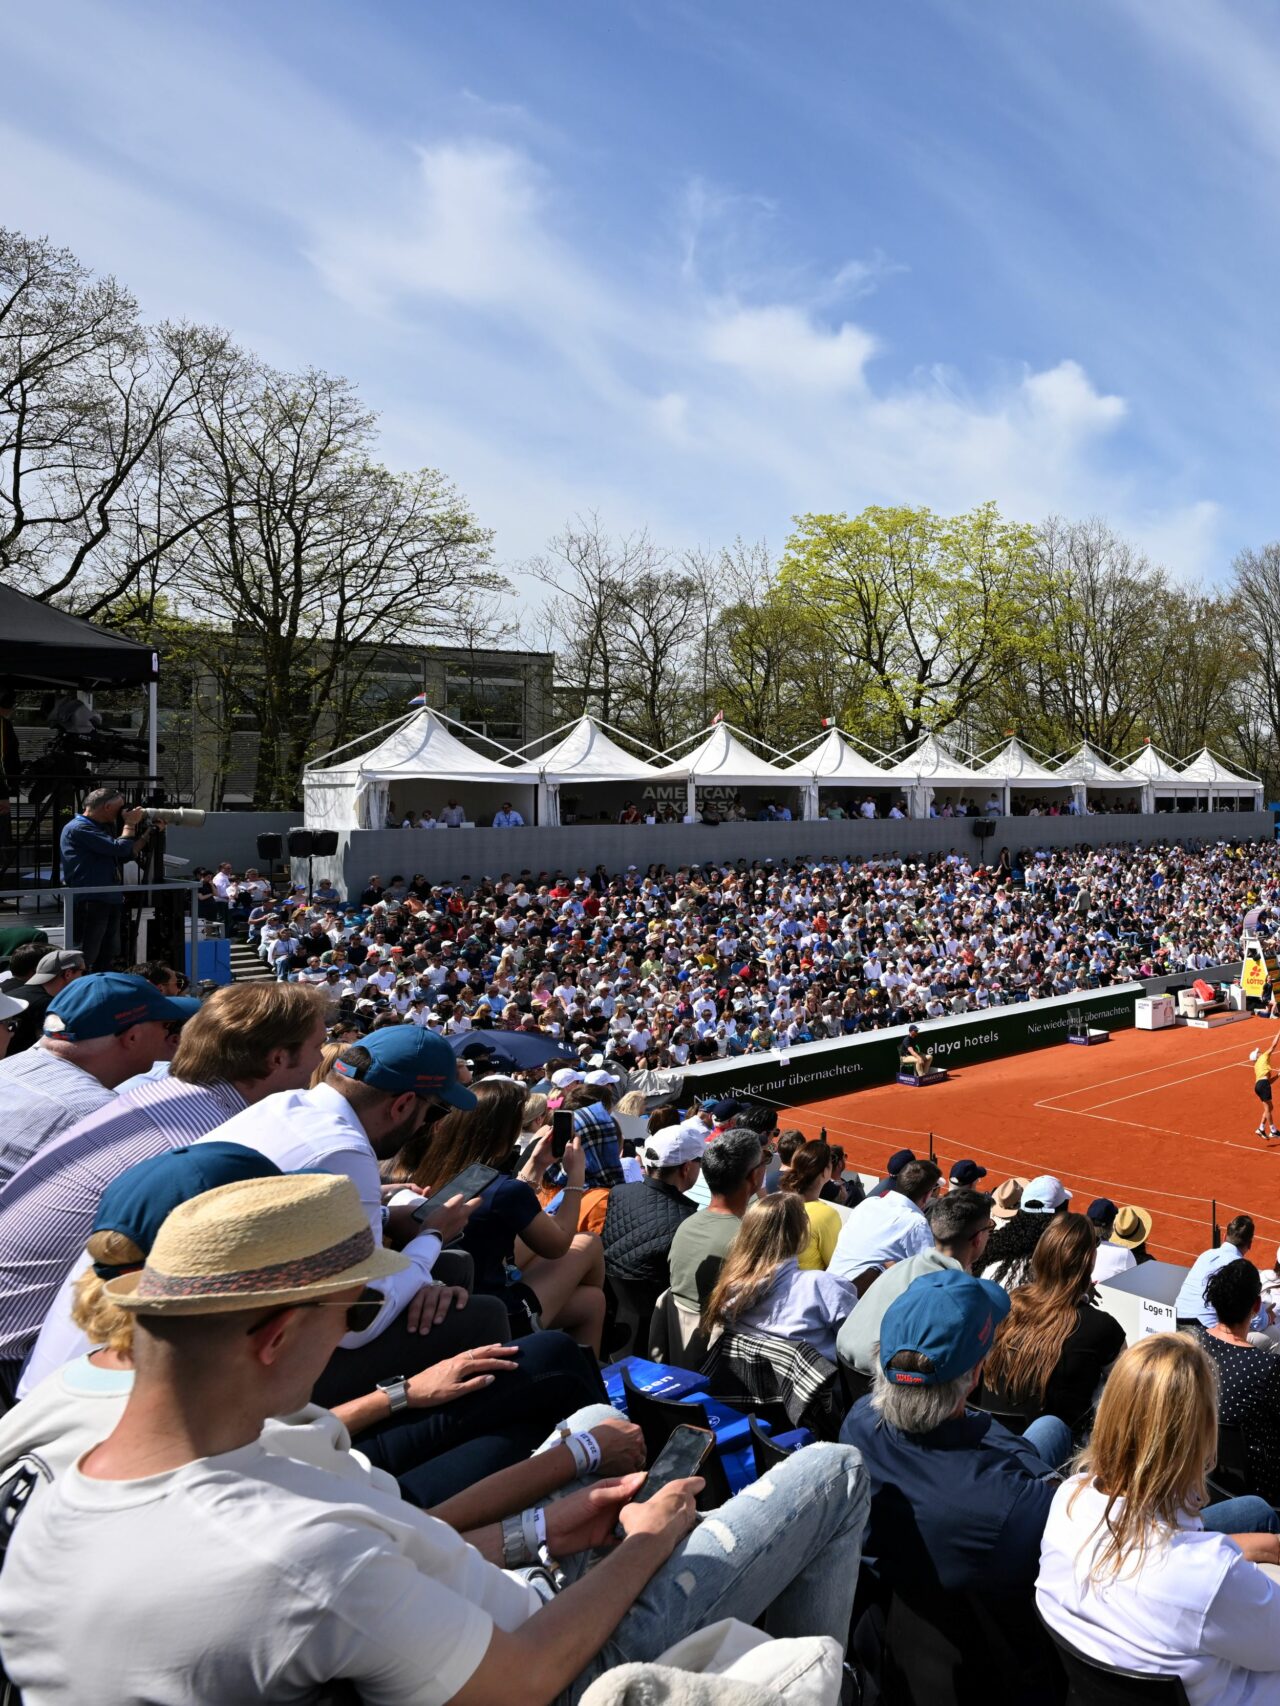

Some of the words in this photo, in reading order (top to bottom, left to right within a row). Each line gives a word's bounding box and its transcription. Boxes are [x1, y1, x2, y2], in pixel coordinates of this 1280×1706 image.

[1027, 1023, 1042, 1034] Nie
[1043, 1018, 1070, 1031] wieder
[1085, 1006, 1131, 1022] übernachten.
[927, 1040, 961, 1055] elaya
[964, 1030, 999, 1047] hotels
[720, 1083, 765, 1102] wieder
[766, 1079, 787, 1091] nur
[788, 1063, 863, 1087] übernachten.
[1143, 1301, 1163, 1316] Loge
[1165, 1308, 1173, 1318] 11
[640, 1375, 674, 1392] pen
